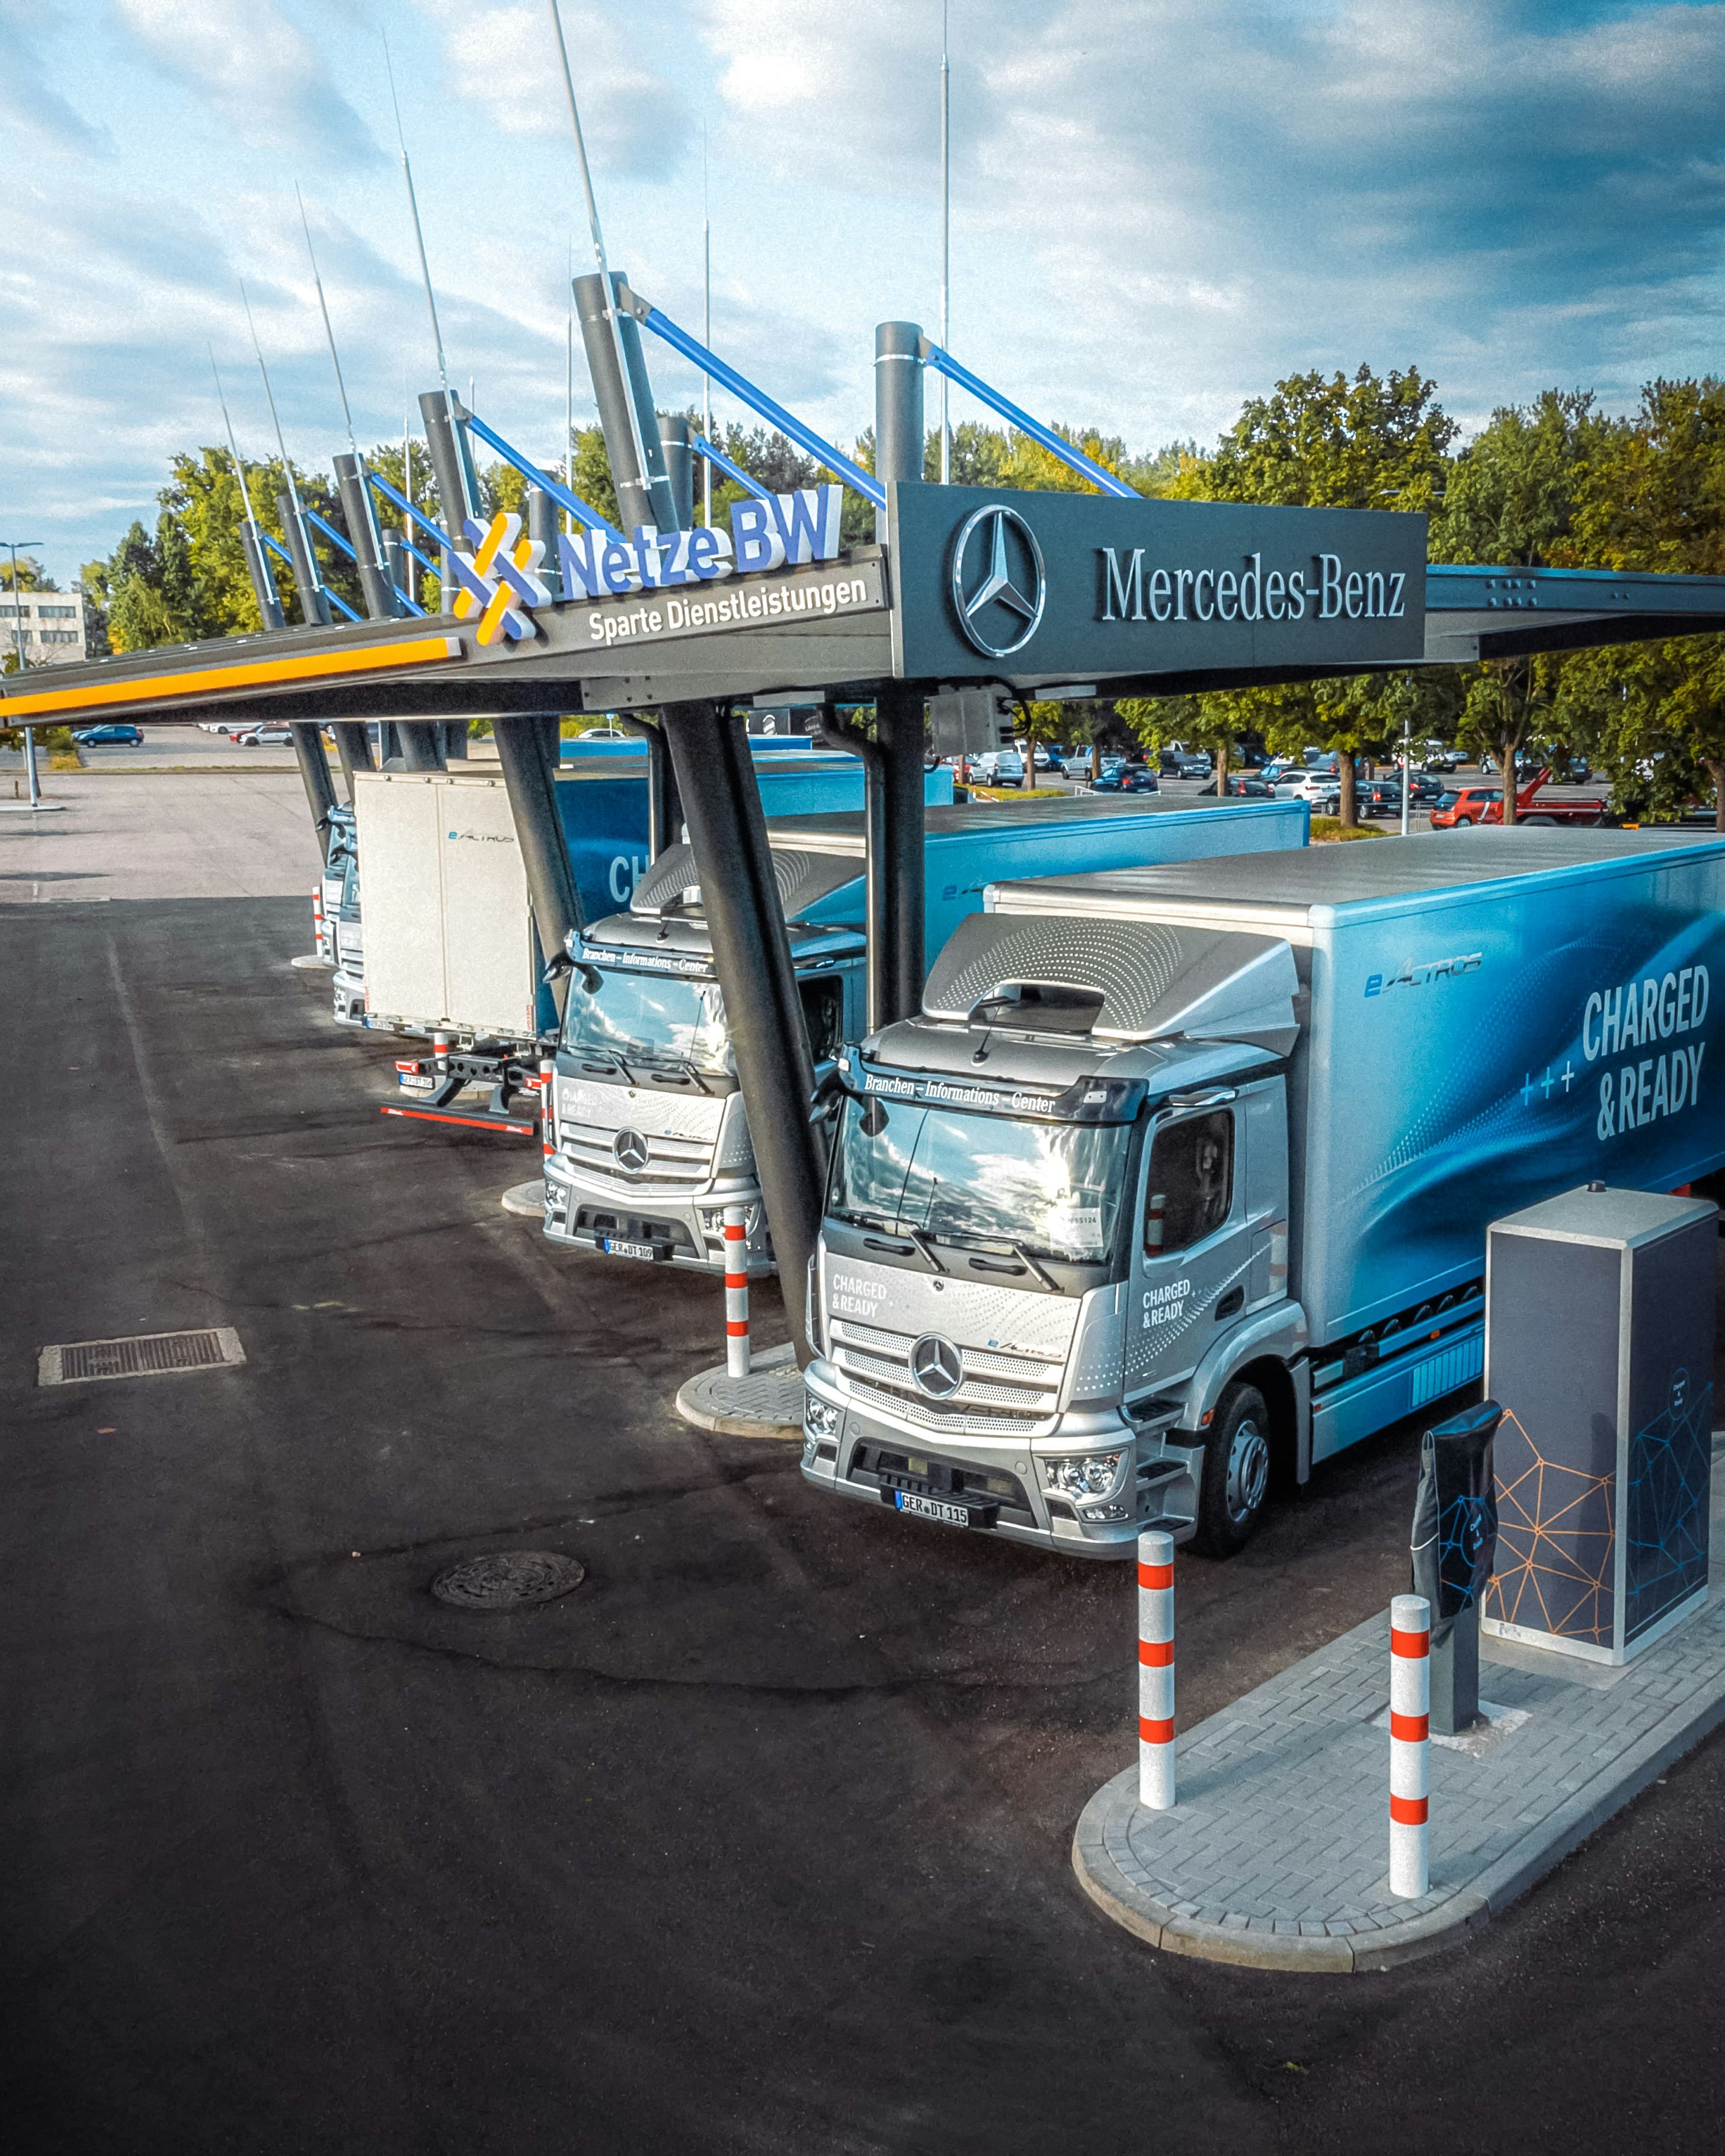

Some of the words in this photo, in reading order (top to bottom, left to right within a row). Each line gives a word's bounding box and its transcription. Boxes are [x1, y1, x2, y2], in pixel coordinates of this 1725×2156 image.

[558, 524, 734, 600] Netze
[731, 485, 844, 572] BW
[1102, 547, 1406, 622] Mercedes-Benz
[588, 610, 661, 646] Sparte
[668, 578, 867, 631] Dienstleistungen
[582, 947, 616, 963] Branchen
[622, 952, 671, 969] Informations
[679, 958, 708, 973] Center
[1583, 965, 1708, 1061] CHARGED
[865, 1074, 914, 1095] Branchen
[925, 1080, 999, 1106] Informations
[1011, 1092, 1056, 1113] Center
[833, 1273, 887, 1300] CHARGED
[1142, 1279, 1191, 1309] CHARGED
[902, 1495, 923, 1512] GER
[930, 1502, 944, 1518] DT
[946, 1506, 966, 1524] 115
